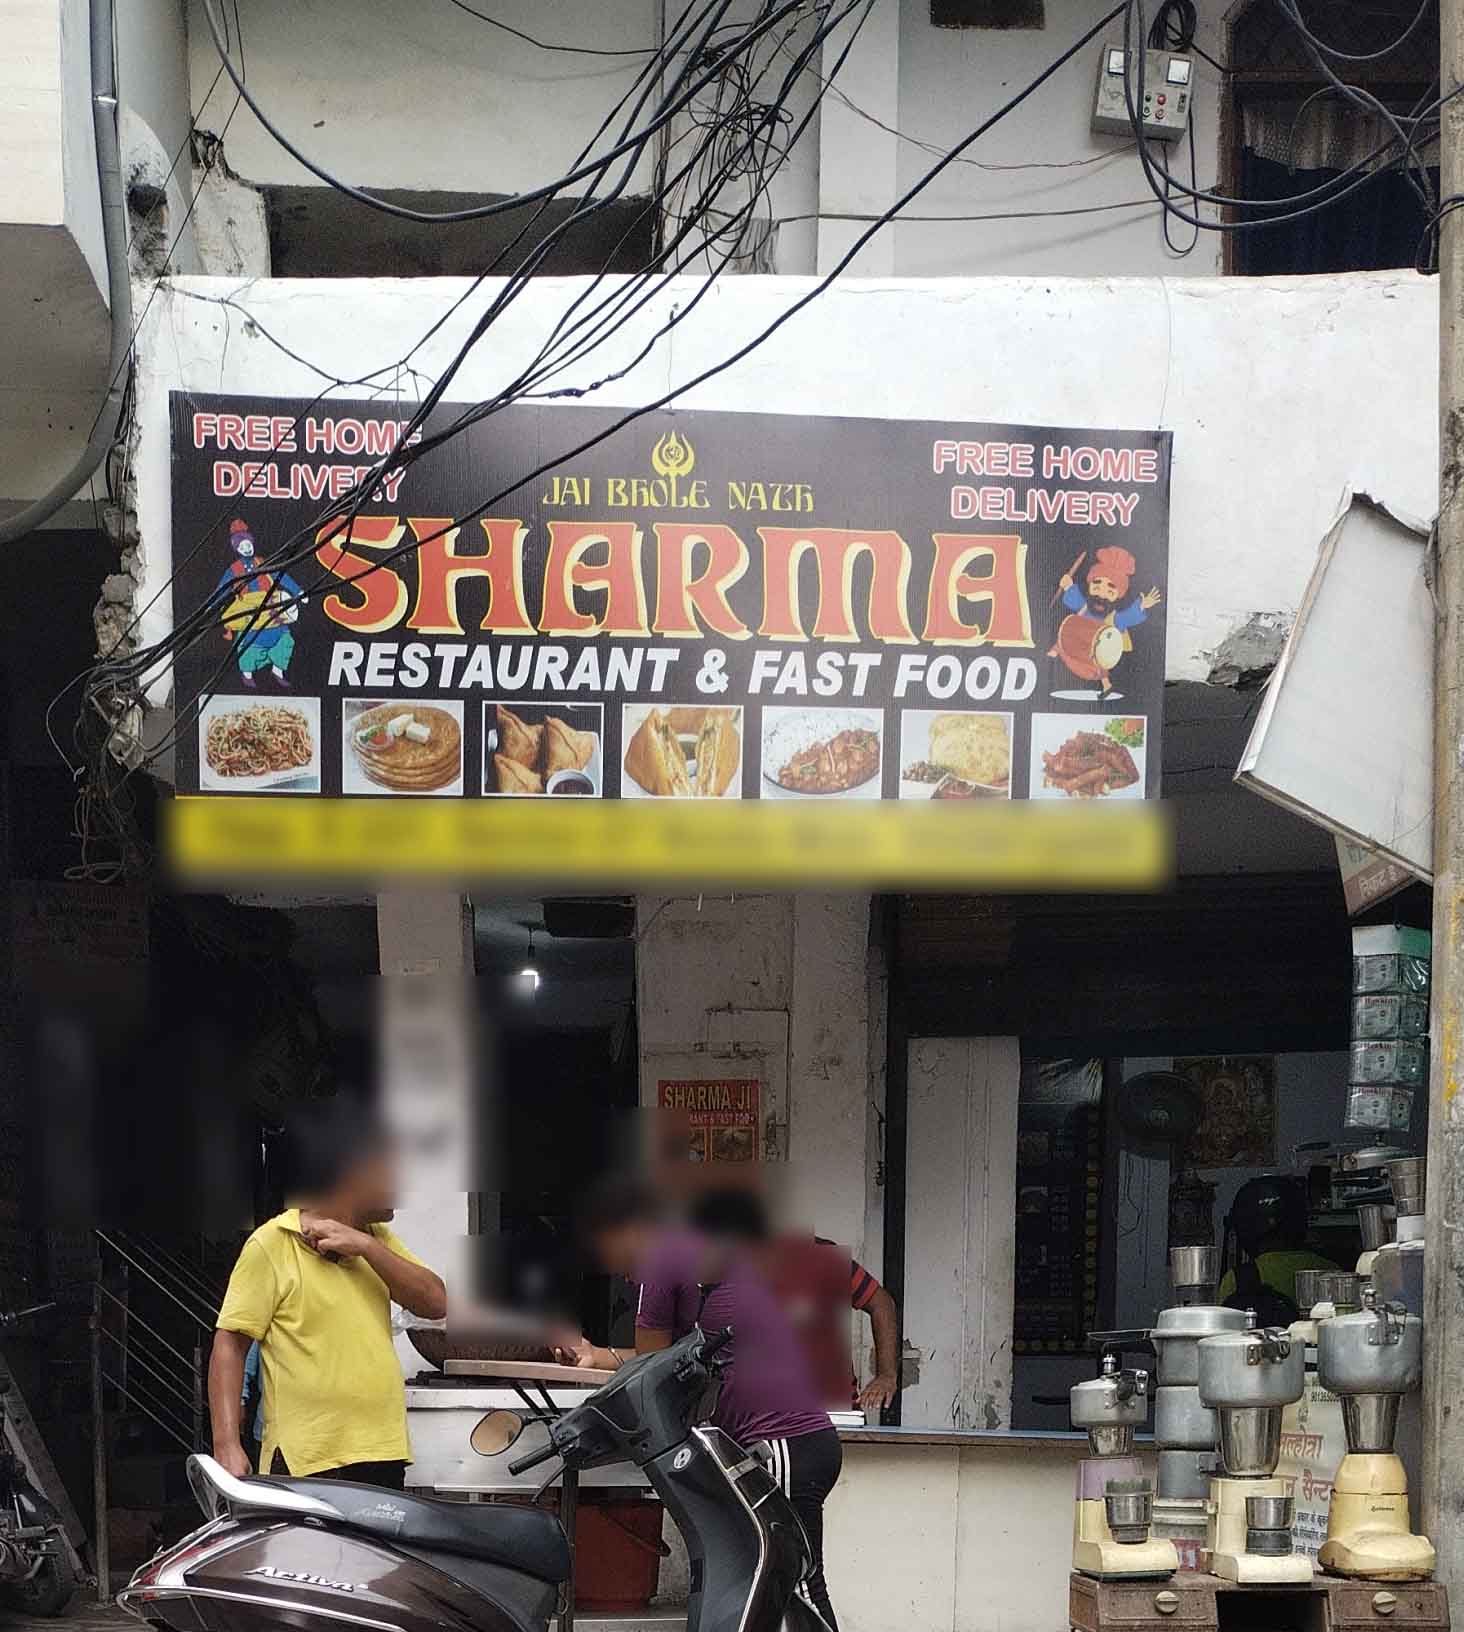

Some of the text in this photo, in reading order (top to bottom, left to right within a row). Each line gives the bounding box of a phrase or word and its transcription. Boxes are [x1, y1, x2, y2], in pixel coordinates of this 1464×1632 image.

[193, 412, 298, 452] FREE
[933, 440, 1158, 482] FREE HOME
[542, 476, 814, 512] JAI BHOLE NATH
[951, 486, 1140, 526] DELIVERY
[315, 514, 1035, 647] SHARMA
[327, 641, 1037, 700] RESTAURANT & FAST FOOD
[664, 1086, 752, 1110] SHARMA JI
[242, 1566, 355, 1593] Activa
